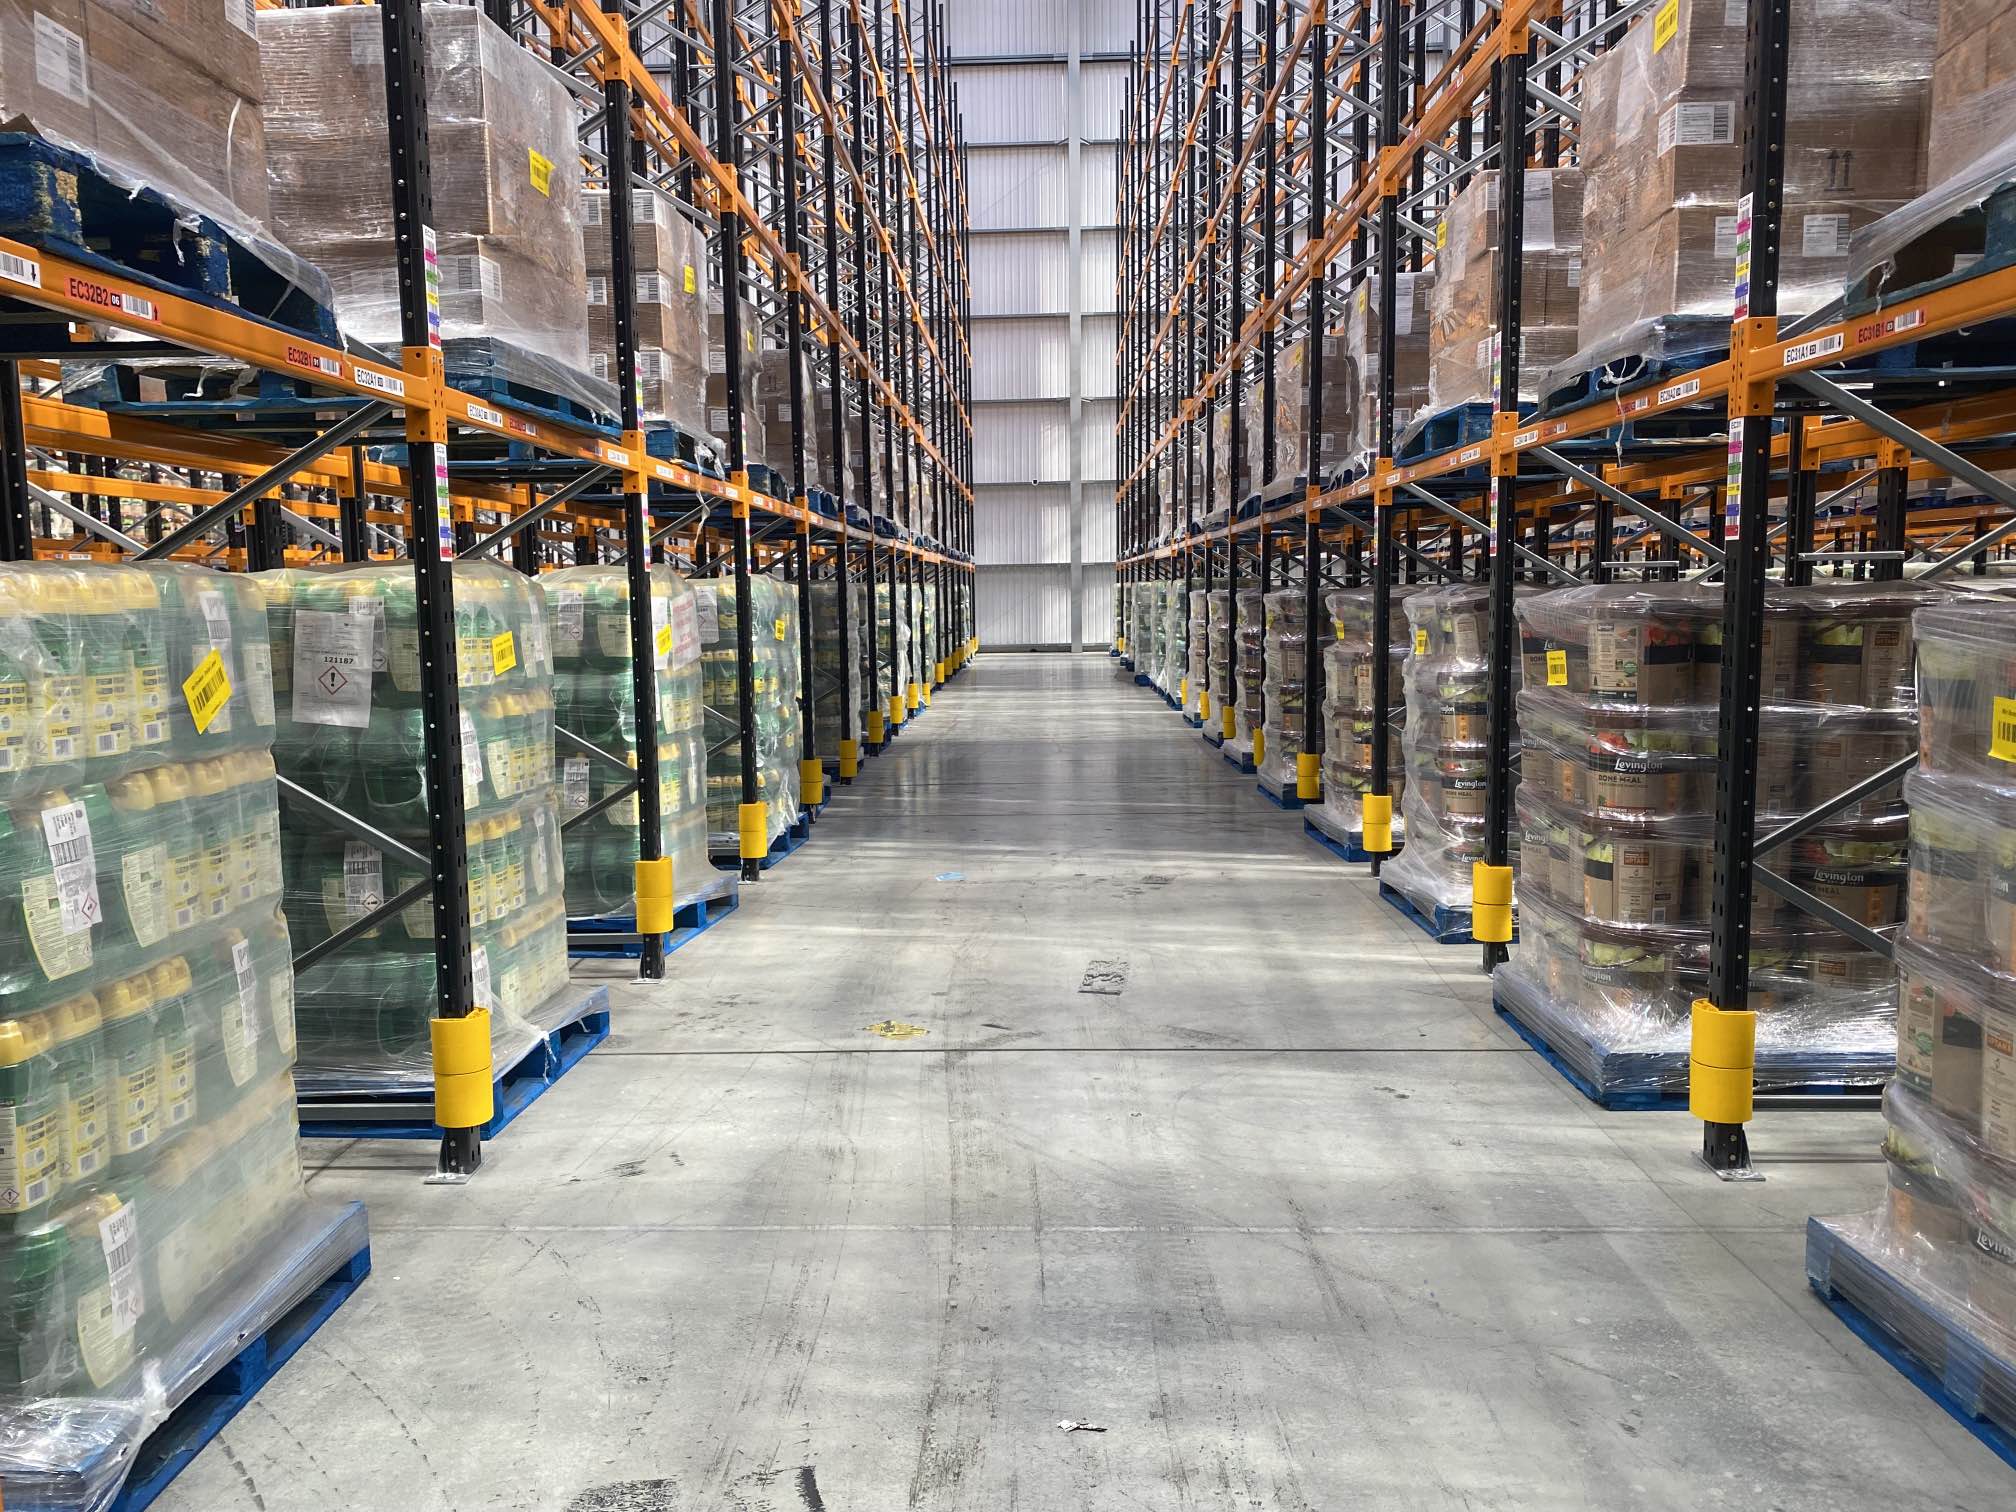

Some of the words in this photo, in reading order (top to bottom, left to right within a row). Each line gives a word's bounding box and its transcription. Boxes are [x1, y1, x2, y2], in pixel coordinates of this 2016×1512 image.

[69, 277, 109, 307] EC32B2
[1858, 321, 1885, 343] EC31B1
[288, 346, 312, 367] EC32B1
[1786, 345, 1809, 363] EC31A1
[323, 656, 354, 665] 121187
[1614, 758, 1663, 773] Levington
[1454, 779, 1487, 789] Levington
[1814, 869, 1864, 885] Levington
